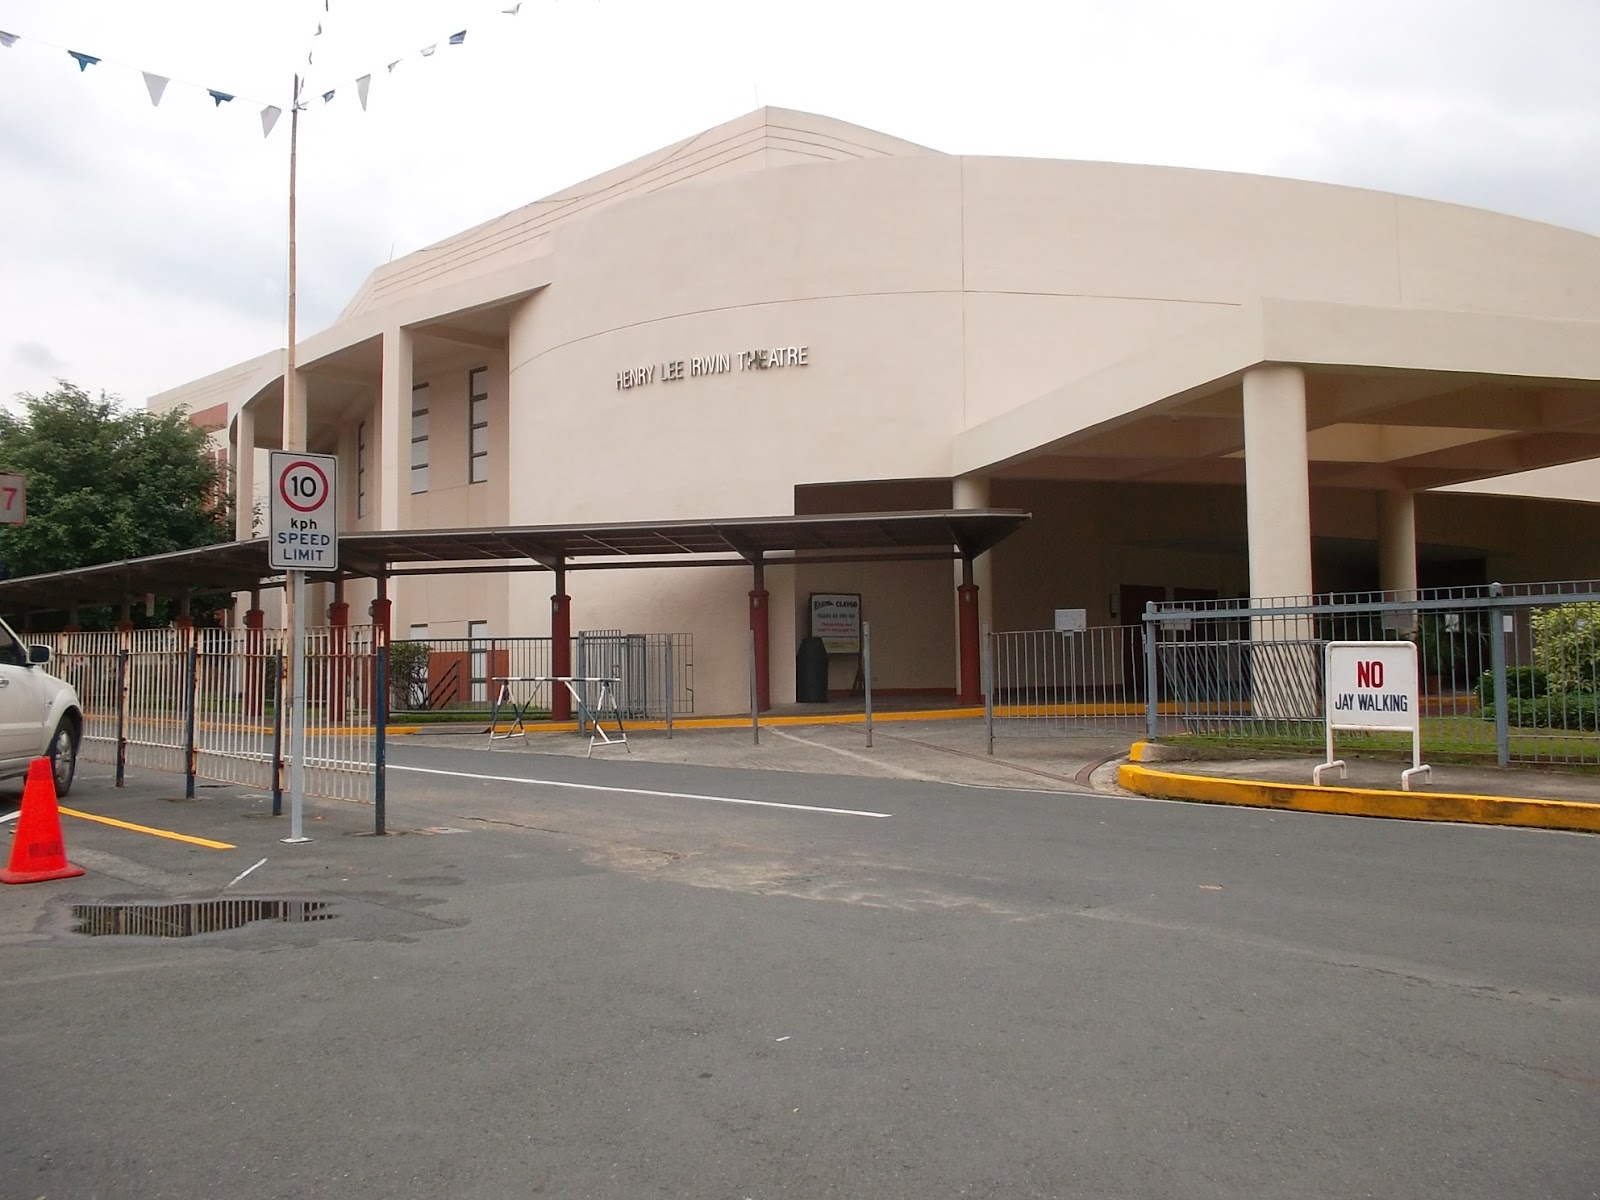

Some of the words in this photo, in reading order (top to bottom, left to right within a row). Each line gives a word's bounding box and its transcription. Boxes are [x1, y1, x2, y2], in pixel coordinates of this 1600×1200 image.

[616, 364, 655, 390] HENRY
[661, 360, 685, 382] LEE
[690, 353, 731, 377] IRWIN
[737, 345, 809, 371] THEATRE
[291, 475, 317, 498] 10
[290, 517, 318, 532] kph
[277, 532, 330, 546] SPEED
[283, 548, 324, 562] LIMIT
[1357, 660, 1384, 689] NO
[1334, 693, 1355, 711] JAY
[1357, 693, 1408, 712] WALKING
